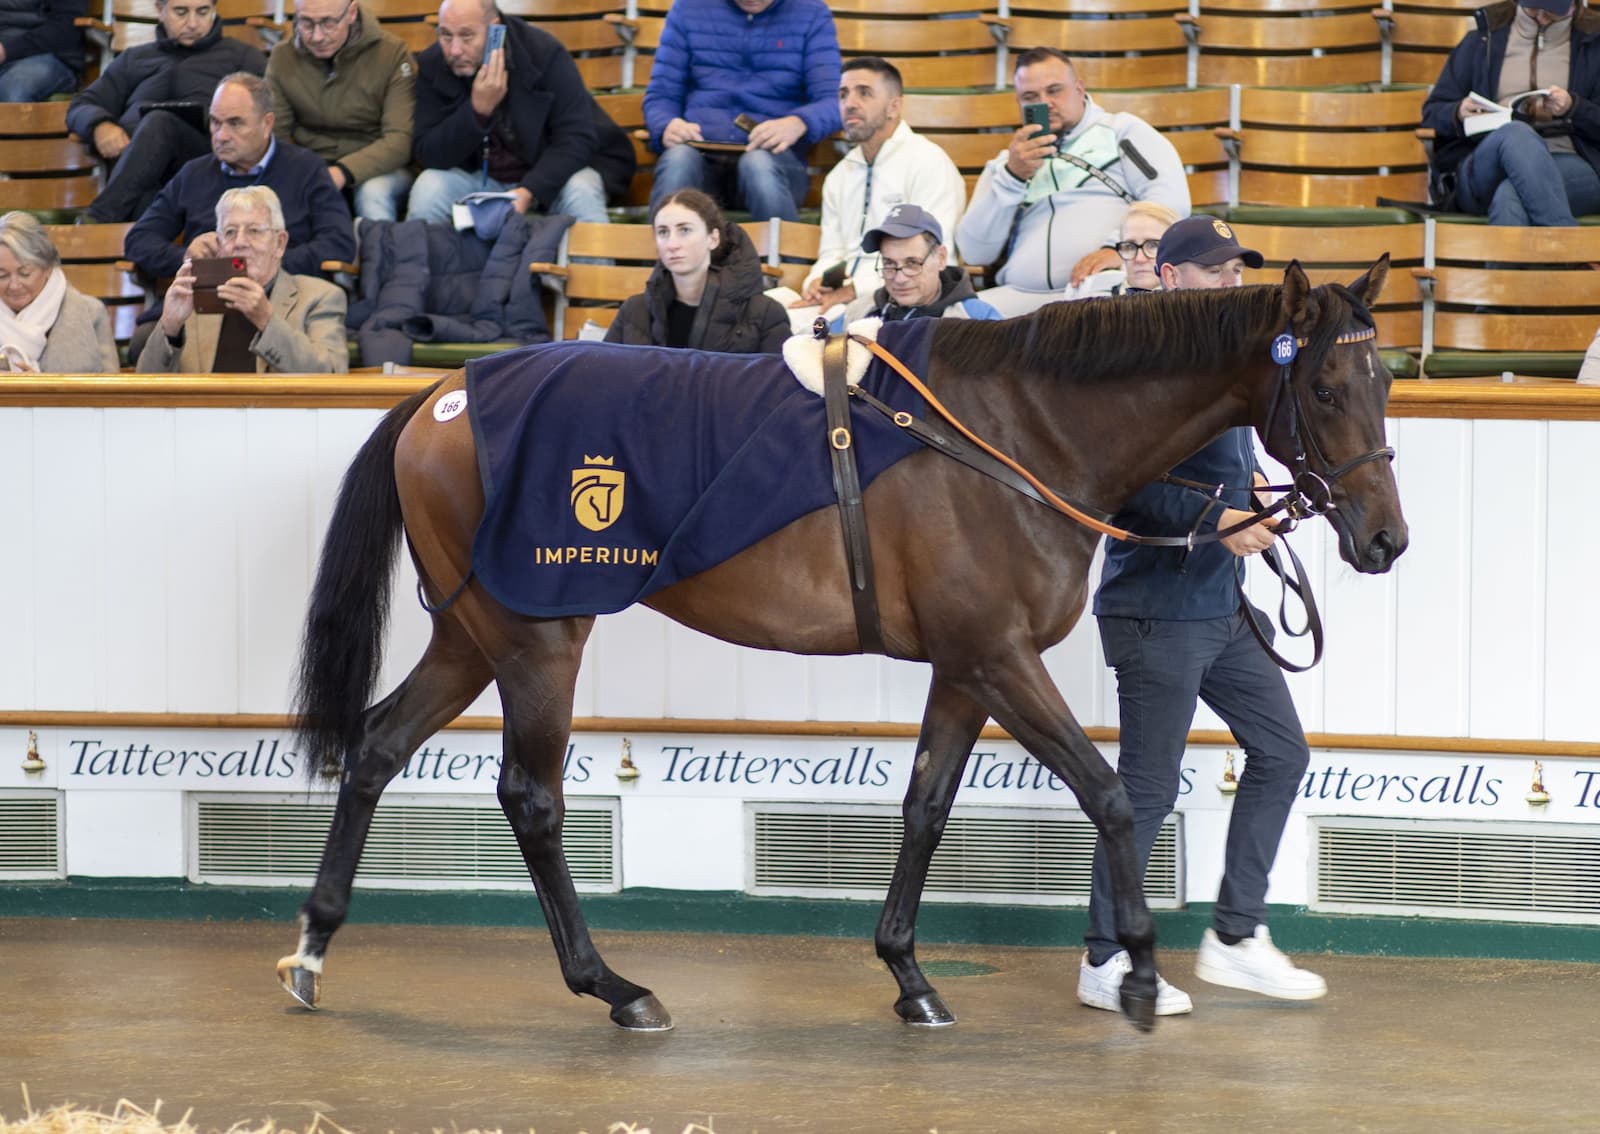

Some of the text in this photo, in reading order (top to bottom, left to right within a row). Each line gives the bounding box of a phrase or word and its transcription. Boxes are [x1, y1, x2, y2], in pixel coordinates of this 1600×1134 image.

[1276, 341, 1292, 358] 166
[441, 401, 461, 413] 166
[535, 547, 658, 566] IMPERIUM
[69, 739, 298, 777] Tattersalls
[661, 746, 892, 787] Tattersalls
[963, 752, 1196, 795] Tattes
[1295, 764, 1503, 806] attersalls
